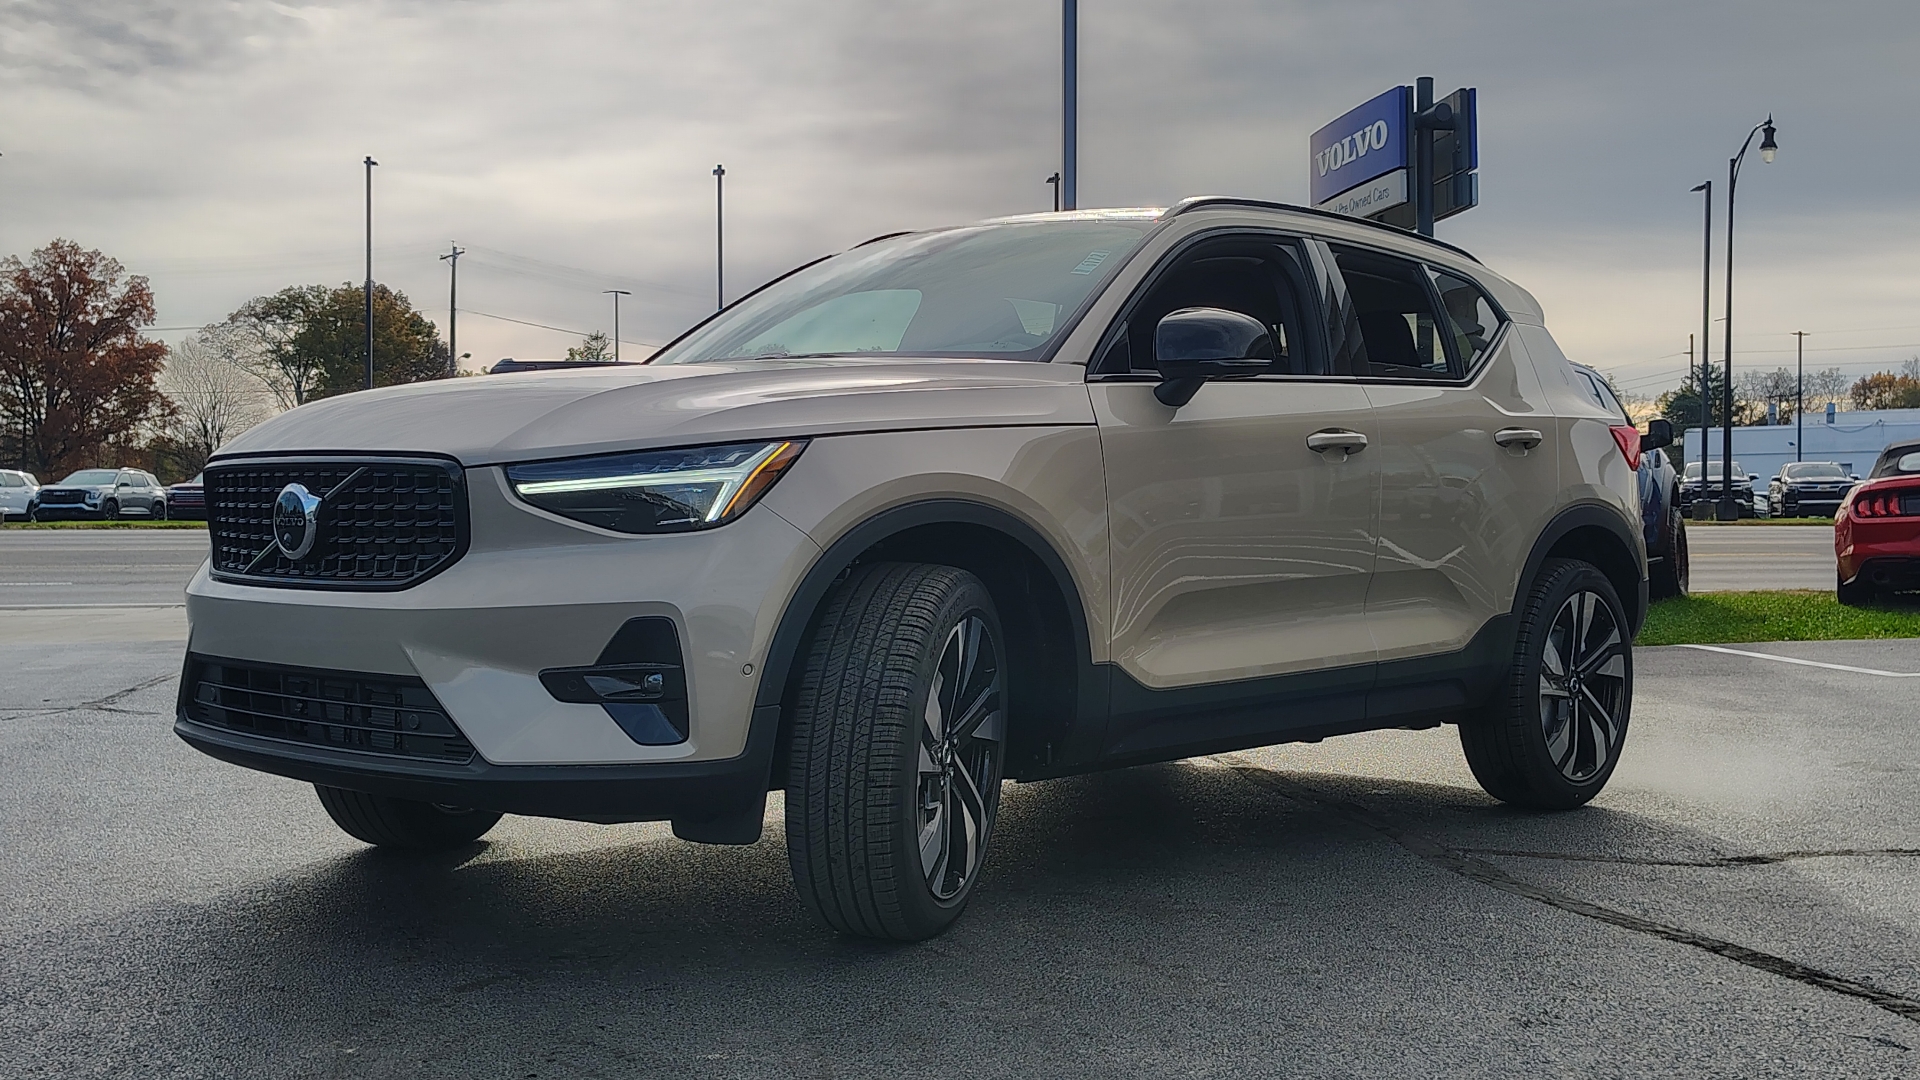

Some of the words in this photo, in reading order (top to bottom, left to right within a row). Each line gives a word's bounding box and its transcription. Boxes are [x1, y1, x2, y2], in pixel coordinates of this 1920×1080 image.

[1315, 119, 1388, 177] VOLVO
[1349, 190, 1371, 212] Owned
[1373, 187, 1389, 202] Cars
[276, 517, 304, 526] VOLVO
